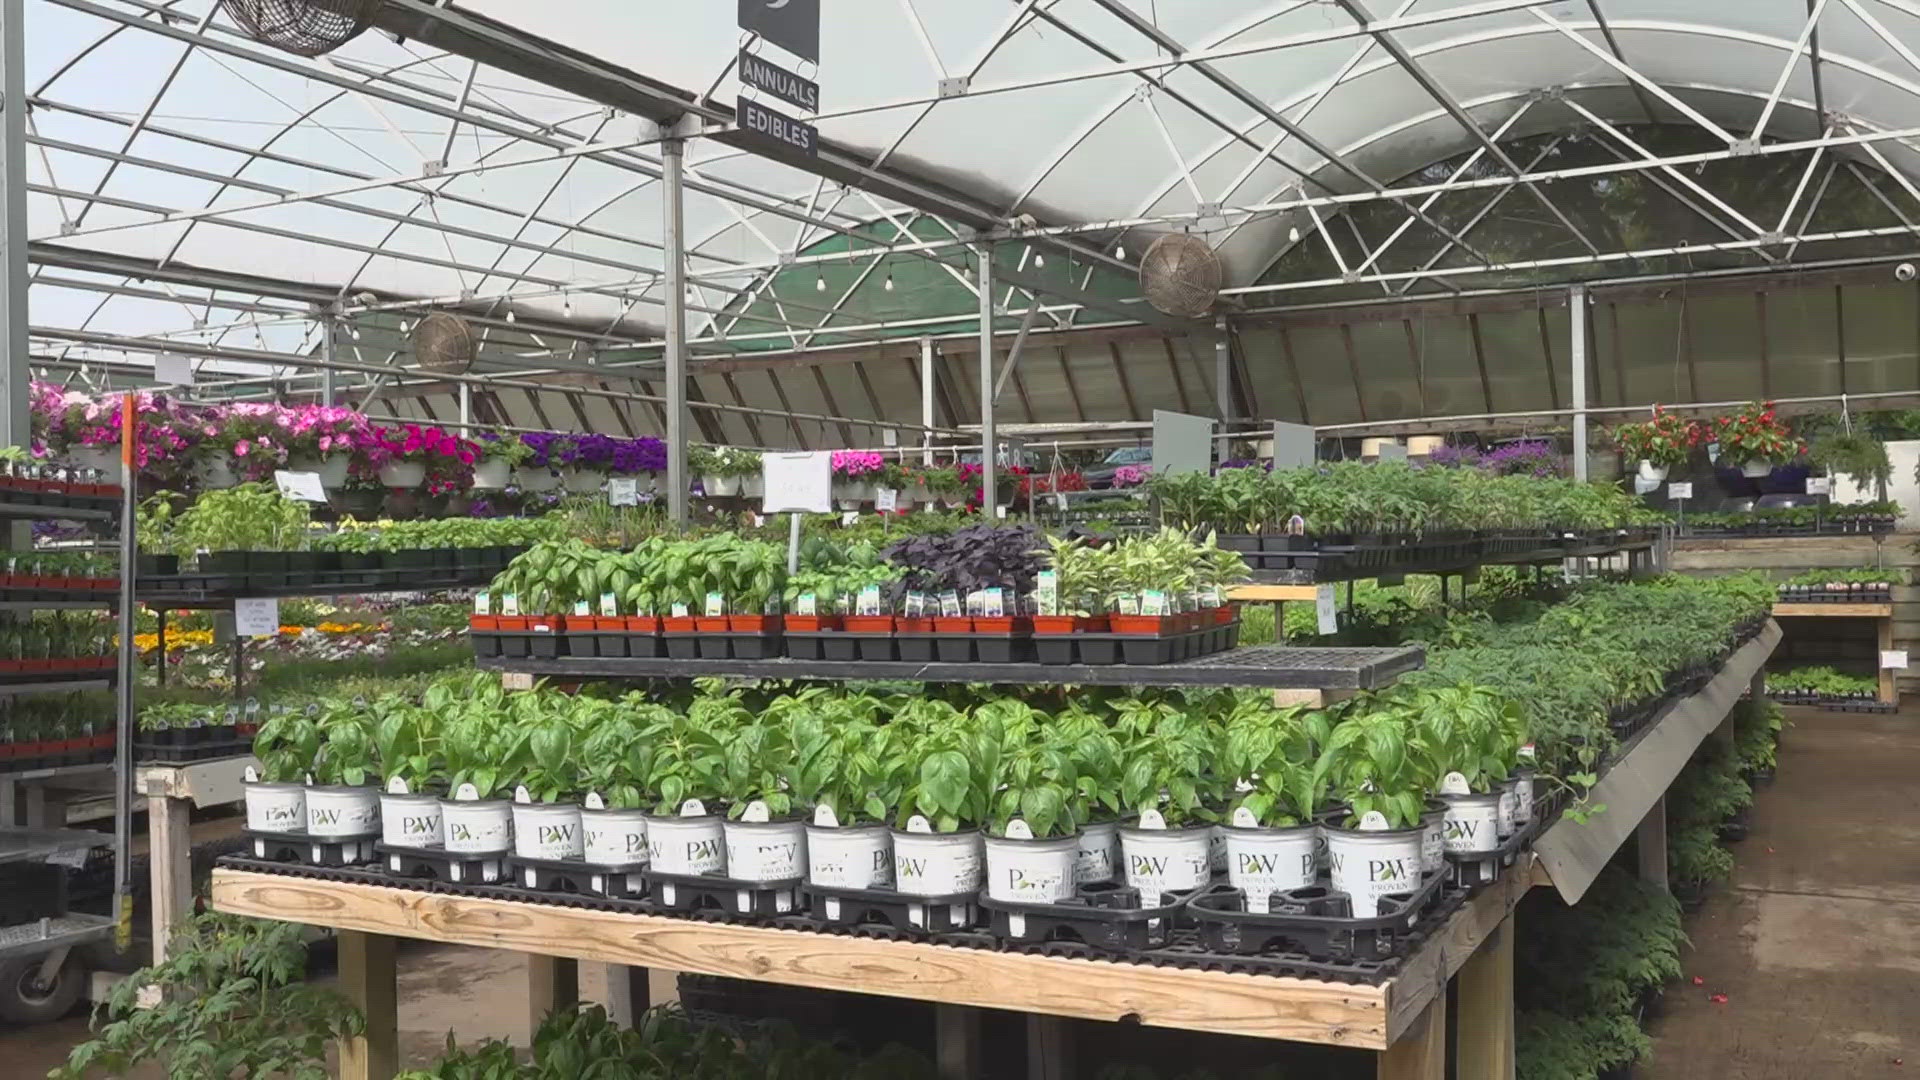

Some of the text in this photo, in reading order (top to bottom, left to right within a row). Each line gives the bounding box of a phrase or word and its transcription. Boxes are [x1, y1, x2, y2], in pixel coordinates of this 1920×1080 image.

[743, 58, 815, 106] ANNUALS
[747, 106, 809, 148] EDIBLES
[311, 808, 341, 825] PW
[403, 815, 440, 834] PW
[539, 823, 576, 845] PW
[687, 838, 722, 861] PW
[897, 855, 927, 878] PW
[1131, 855, 1169, 876] PW
[1239, 852, 1279, 874] PW
[1368, 859, 1406, 881] PW
[1371, 882, 1408, 890] PROVEN
